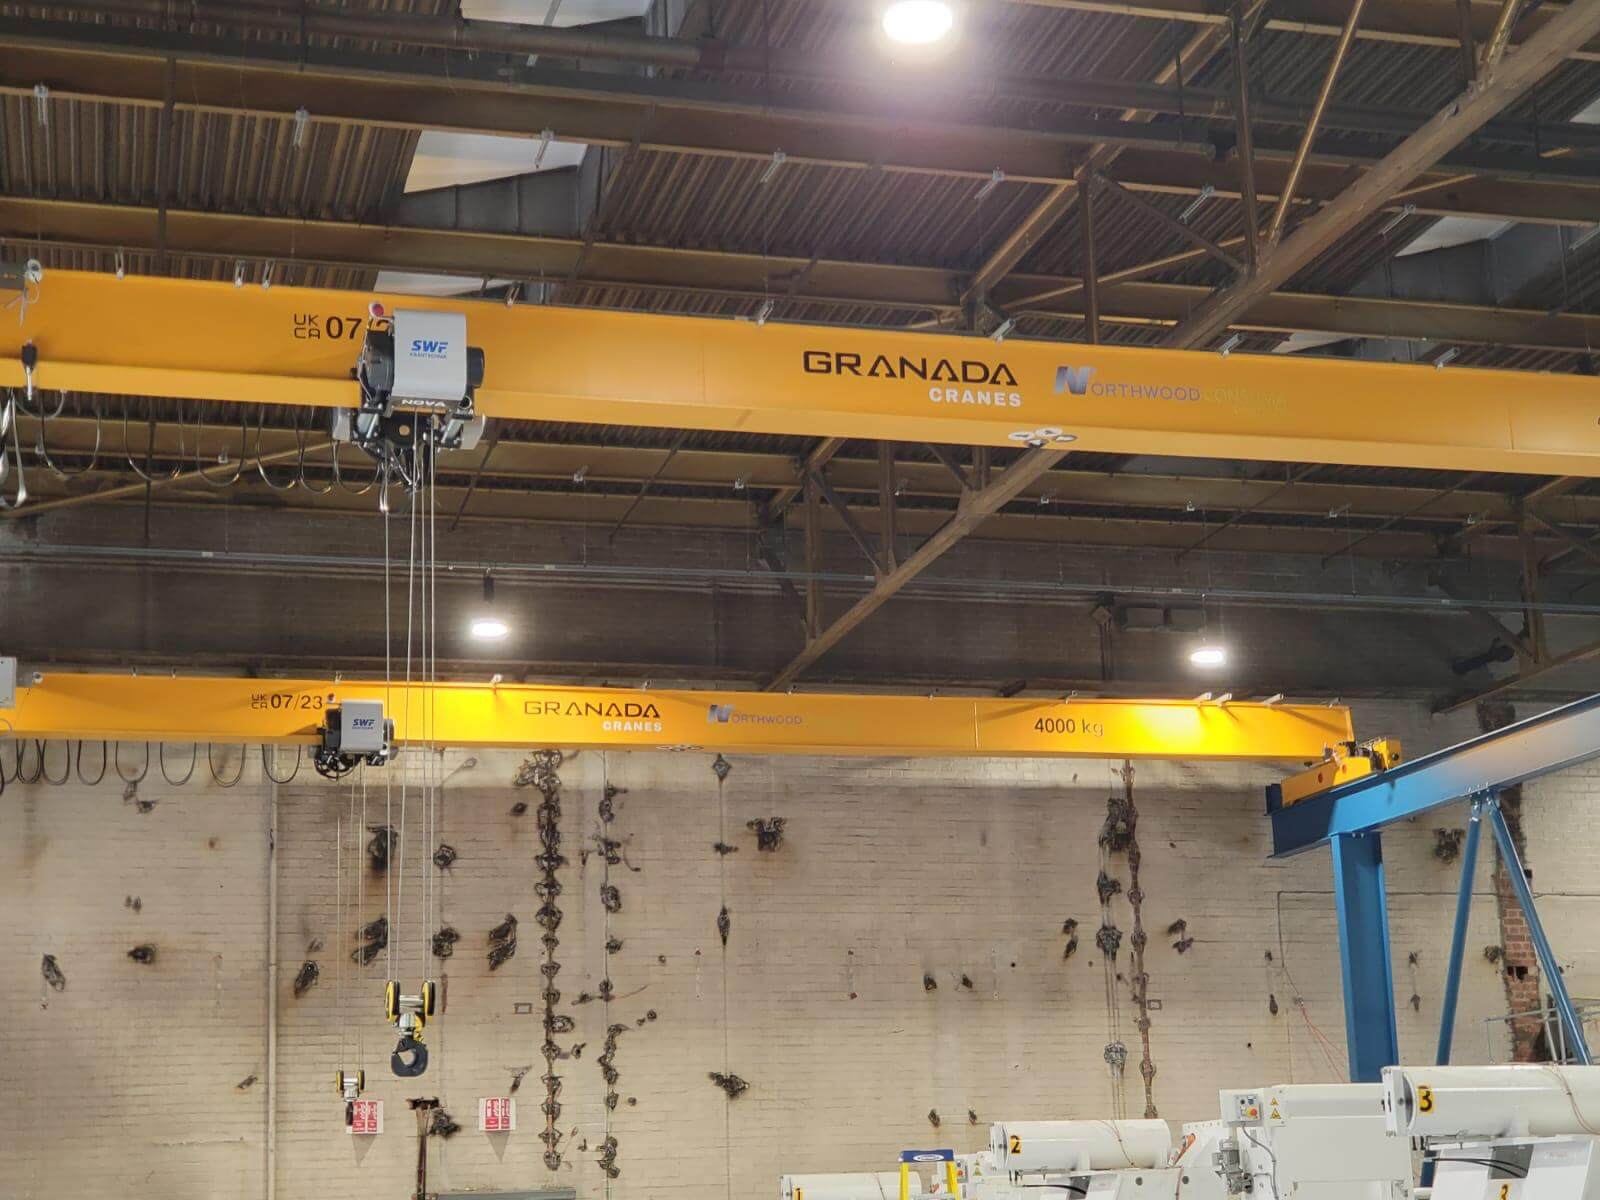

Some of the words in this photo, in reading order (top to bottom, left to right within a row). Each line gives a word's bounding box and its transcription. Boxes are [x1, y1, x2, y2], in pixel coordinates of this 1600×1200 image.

[411, 340, 448, 353] SWF
[803, 350, 1019, 386] GRANADA
[402, 399, 446, 408] NOVA
[928, 387, 1022, 408] CRANES
[270, 694, 323, 710] 07/23
[524, 701, 661, 719] GRANADA
[352, 718, 375, 727] SWF
[602, 720, 662, 732] CRANES
[1034, 718, 1076, 733] 4000
[1082, 719, 1104, 736] kg
[1418, 1085, 1433, 1113] 3
[1010, 1134, 1021, 1154] 2
